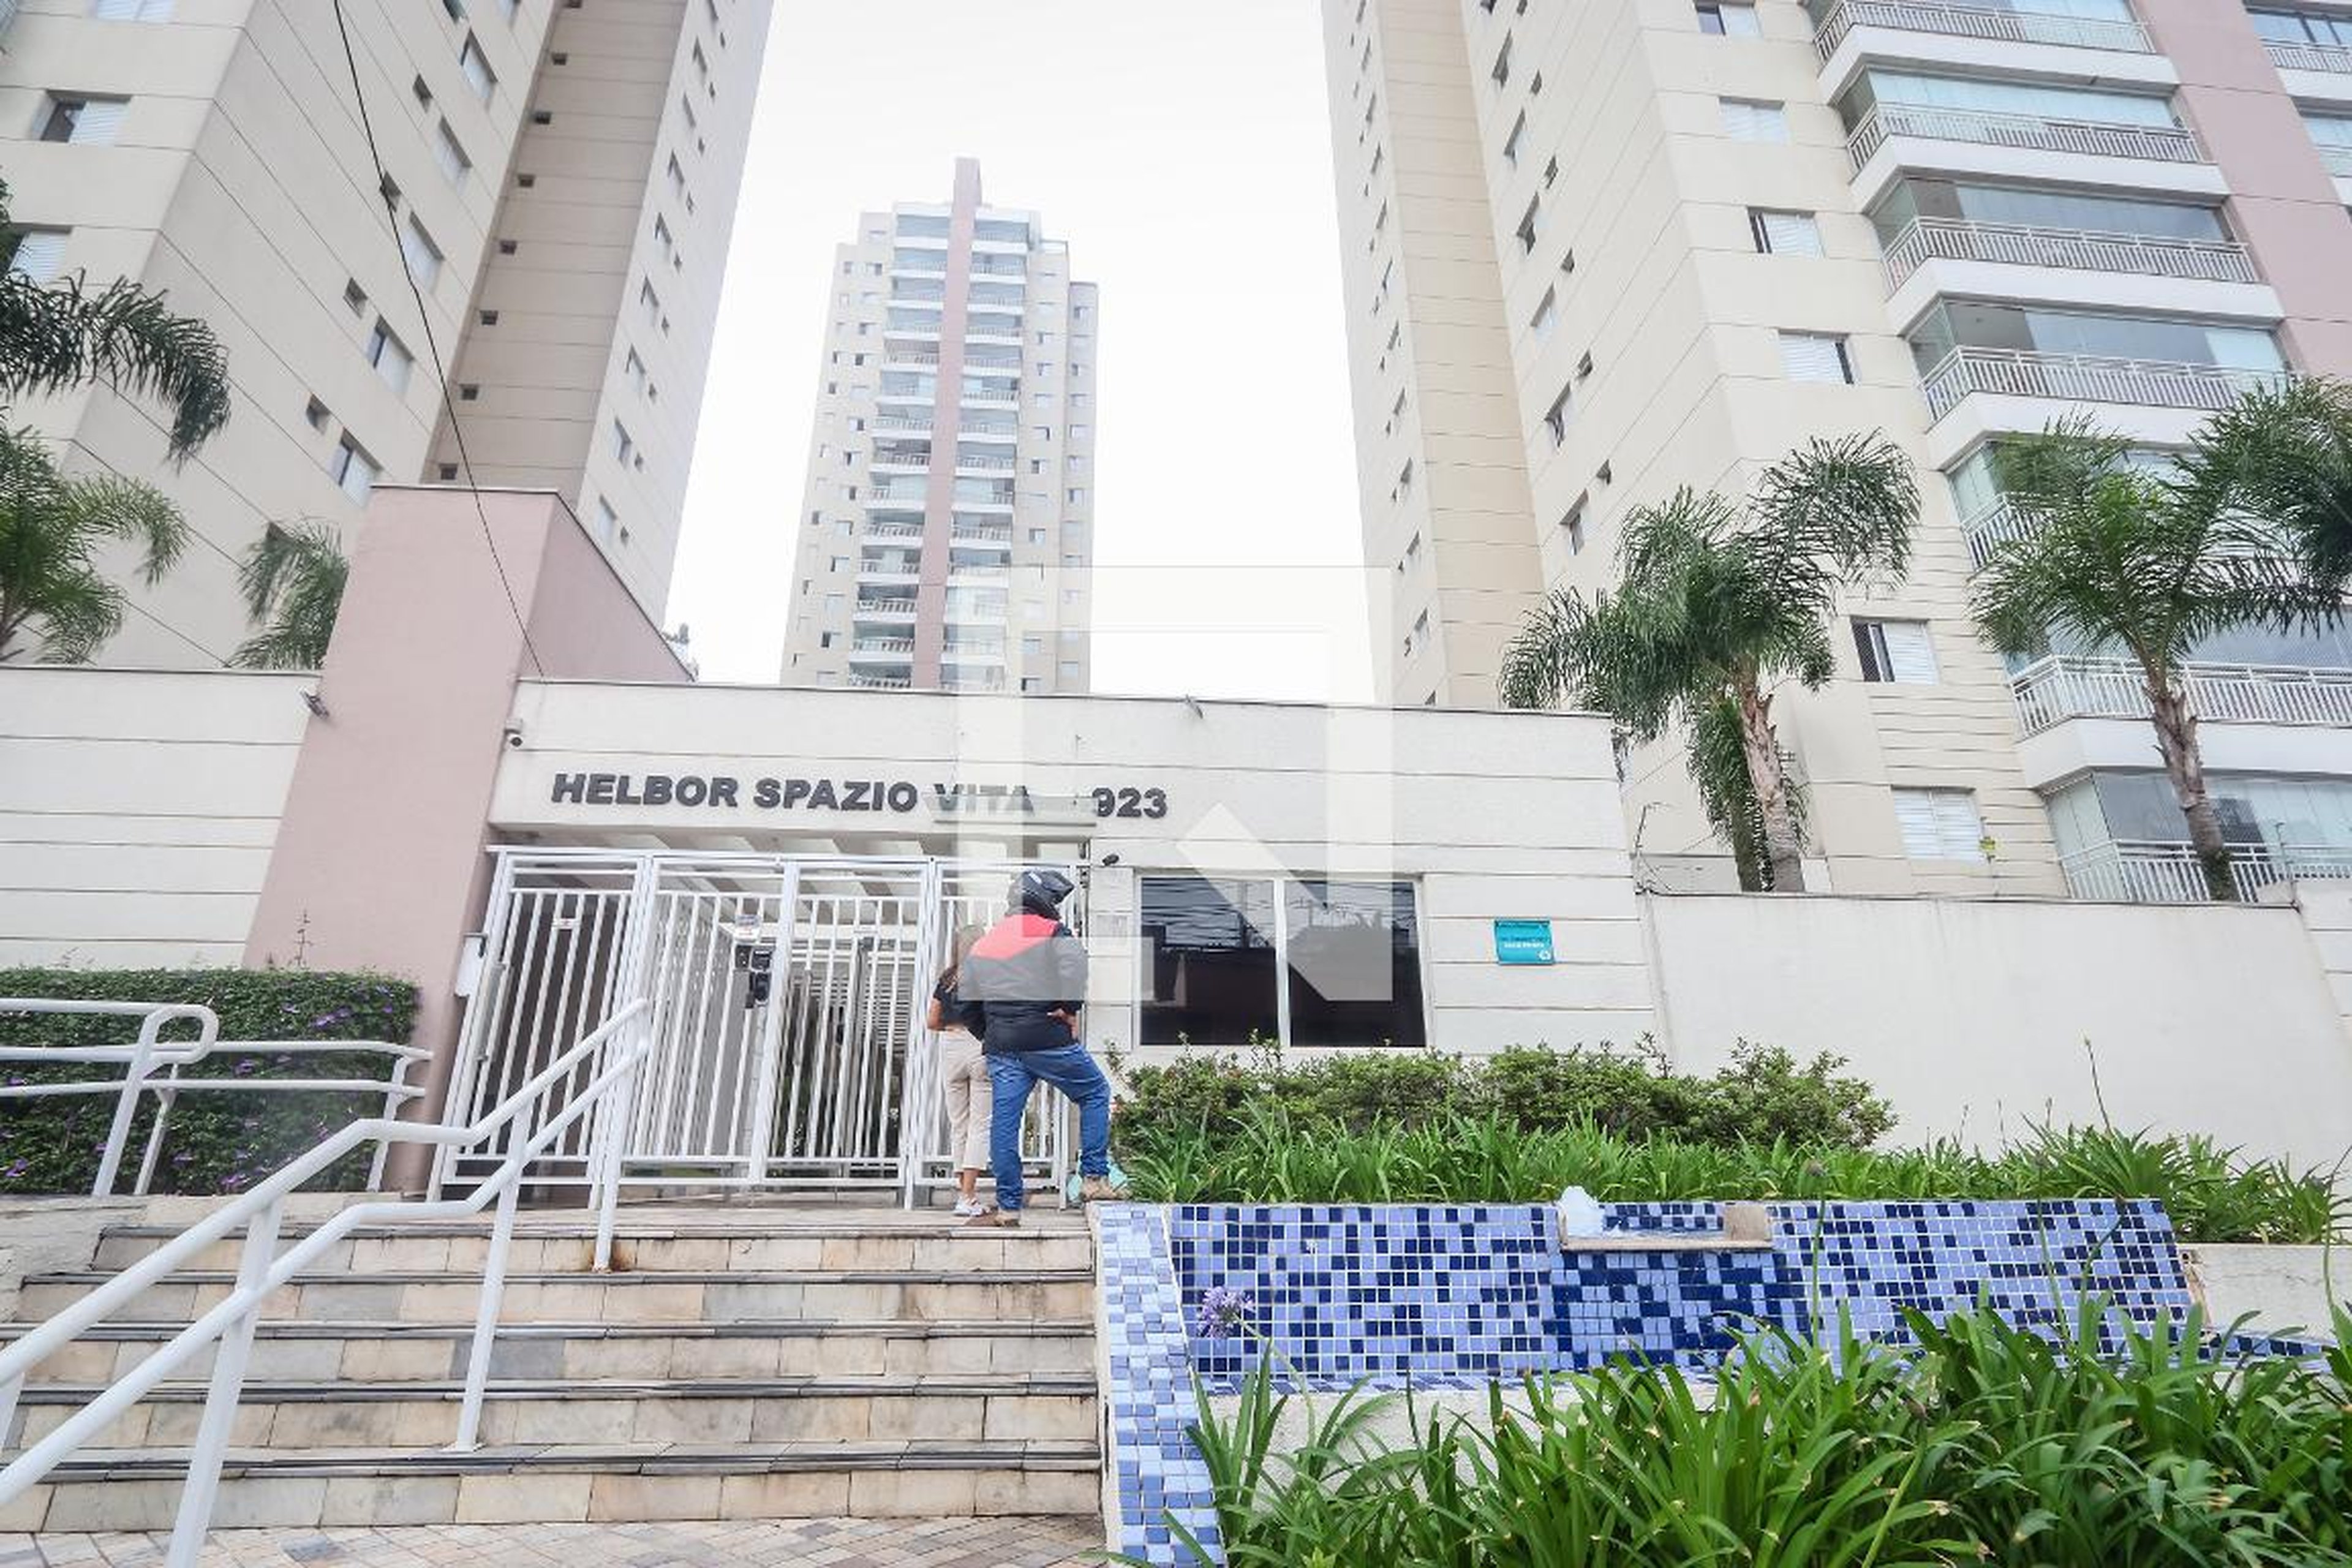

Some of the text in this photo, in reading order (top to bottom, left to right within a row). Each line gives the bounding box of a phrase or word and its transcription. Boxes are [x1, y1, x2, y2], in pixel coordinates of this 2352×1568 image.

[551, 773, 1168, 819] HELBOR SPAZIO VITA 923
